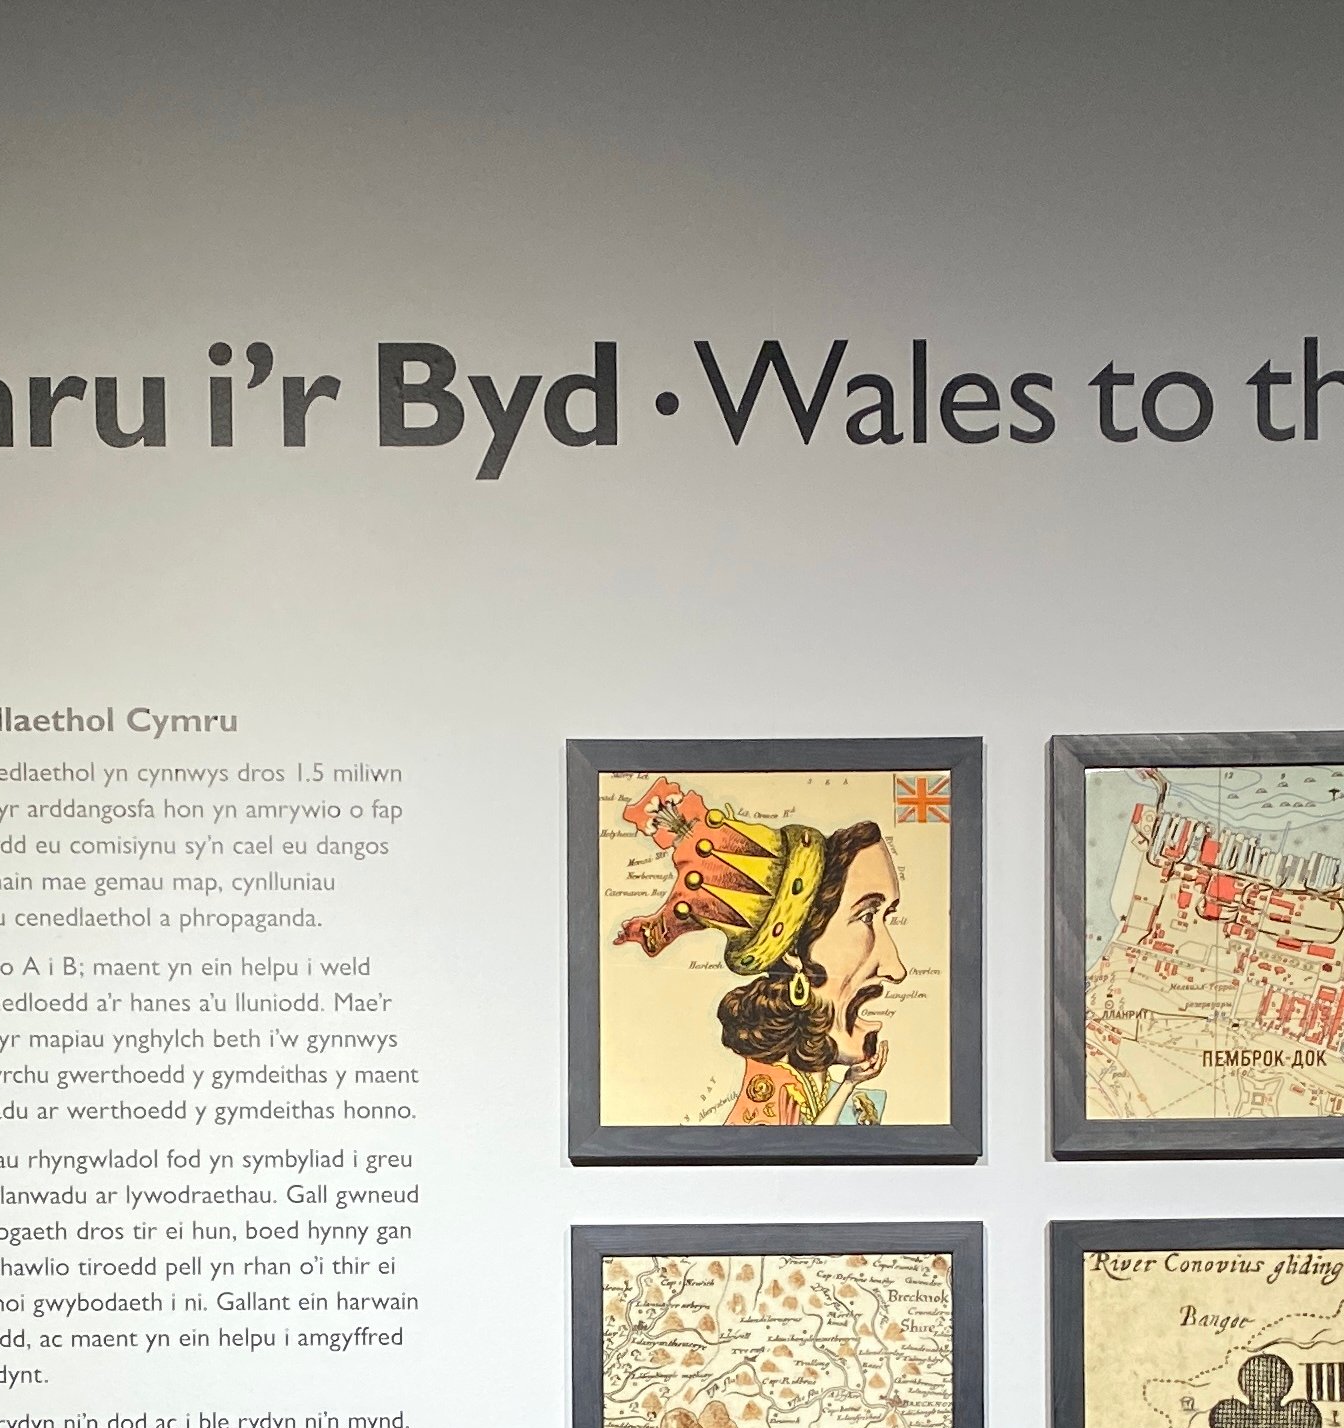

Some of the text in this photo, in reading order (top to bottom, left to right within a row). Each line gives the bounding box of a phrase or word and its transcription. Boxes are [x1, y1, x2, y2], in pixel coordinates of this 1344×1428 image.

[378, 341, 618, 482] Byd
[693, 338, 1056, 446] Wales
[1088, 360, 1215, 442] to
[126, 707, 238, 740] Cymru
[103, 768, 128, 788] yn
[137, 768, 229, 789] cynnwys
[237, 762, 285, 782] dros
[296, 762, 324, 783] 1.5
[333, 762, 402, 783] miliwn
[14, 906, 151, 927] cenedlaethol
[159, 912, 171, 927] a
[179, 906, 323, 934] phropaganda.
[1202, 1049, 1327, 1068] ПЕМБРОК-ДОК
[1089, 1252, 1157, 1281] River
[1164, 1253, 1265, 1273] Conovius
[1266, 1253, 1344, 1285] gliding
